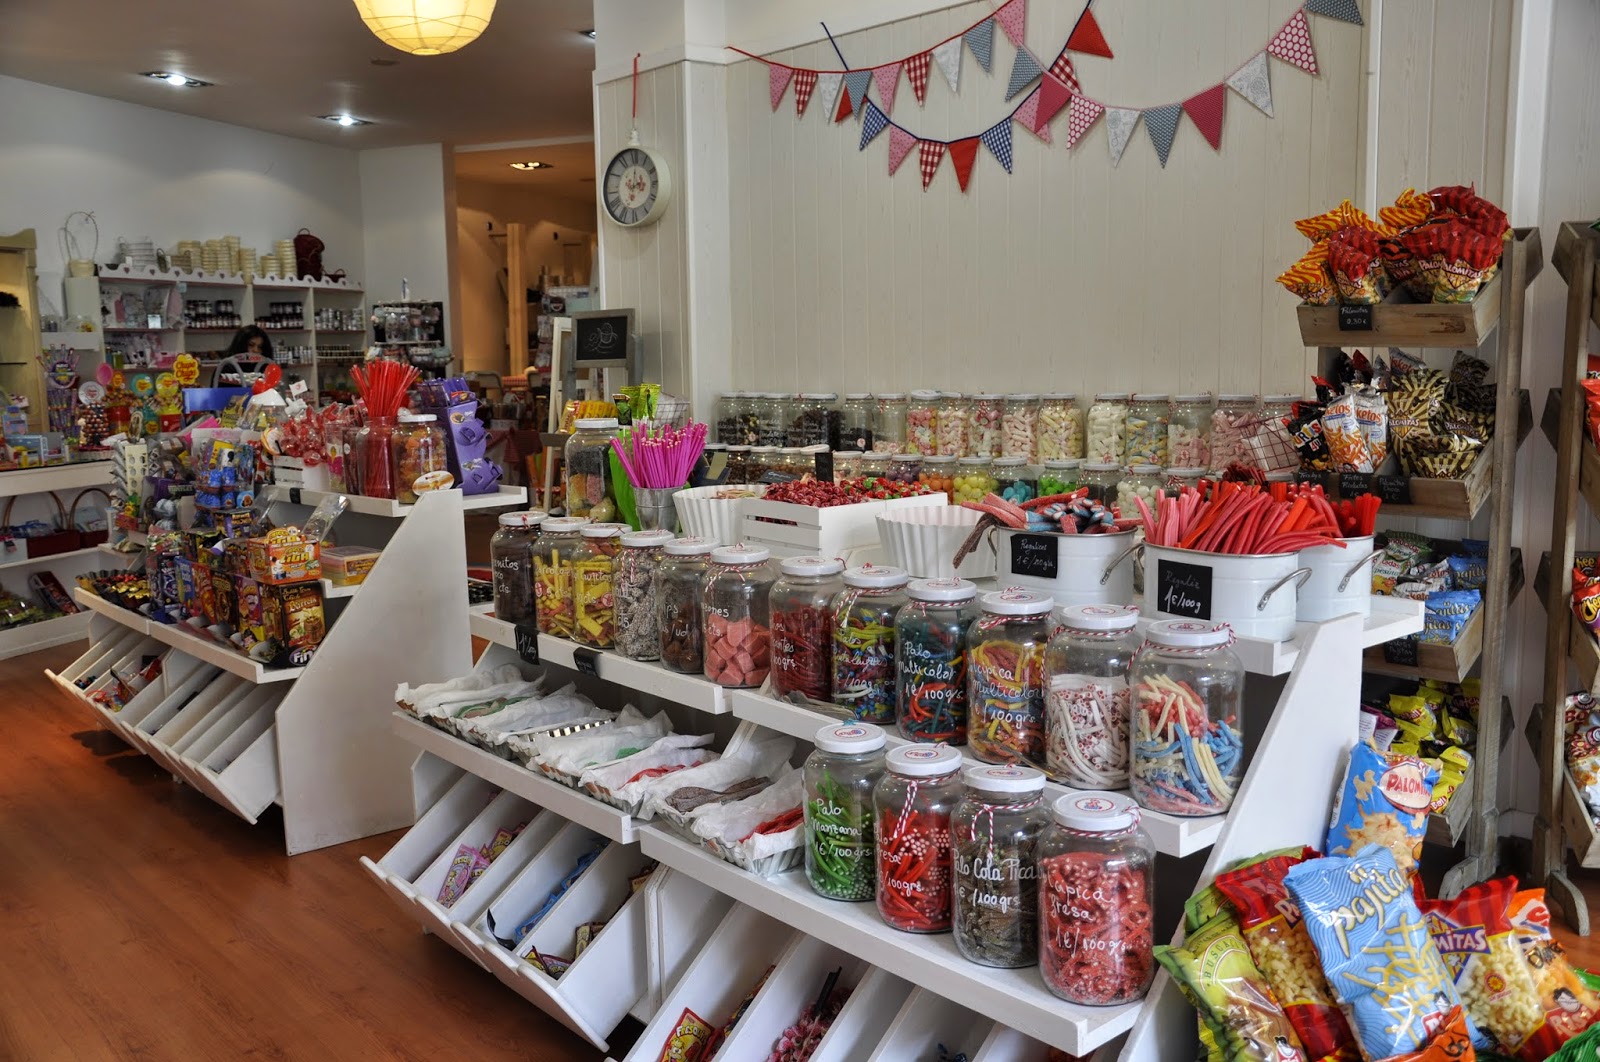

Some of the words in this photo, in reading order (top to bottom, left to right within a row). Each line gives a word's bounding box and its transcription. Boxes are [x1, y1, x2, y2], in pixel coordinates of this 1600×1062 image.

[293, 646, 317, 663] Fin
[904, 641, 932, 659] Palo
[815, 797, 843, 816] Palo
[811, 816, 863, 837] Manzana
[972, 857, 1005, 882] Cola
